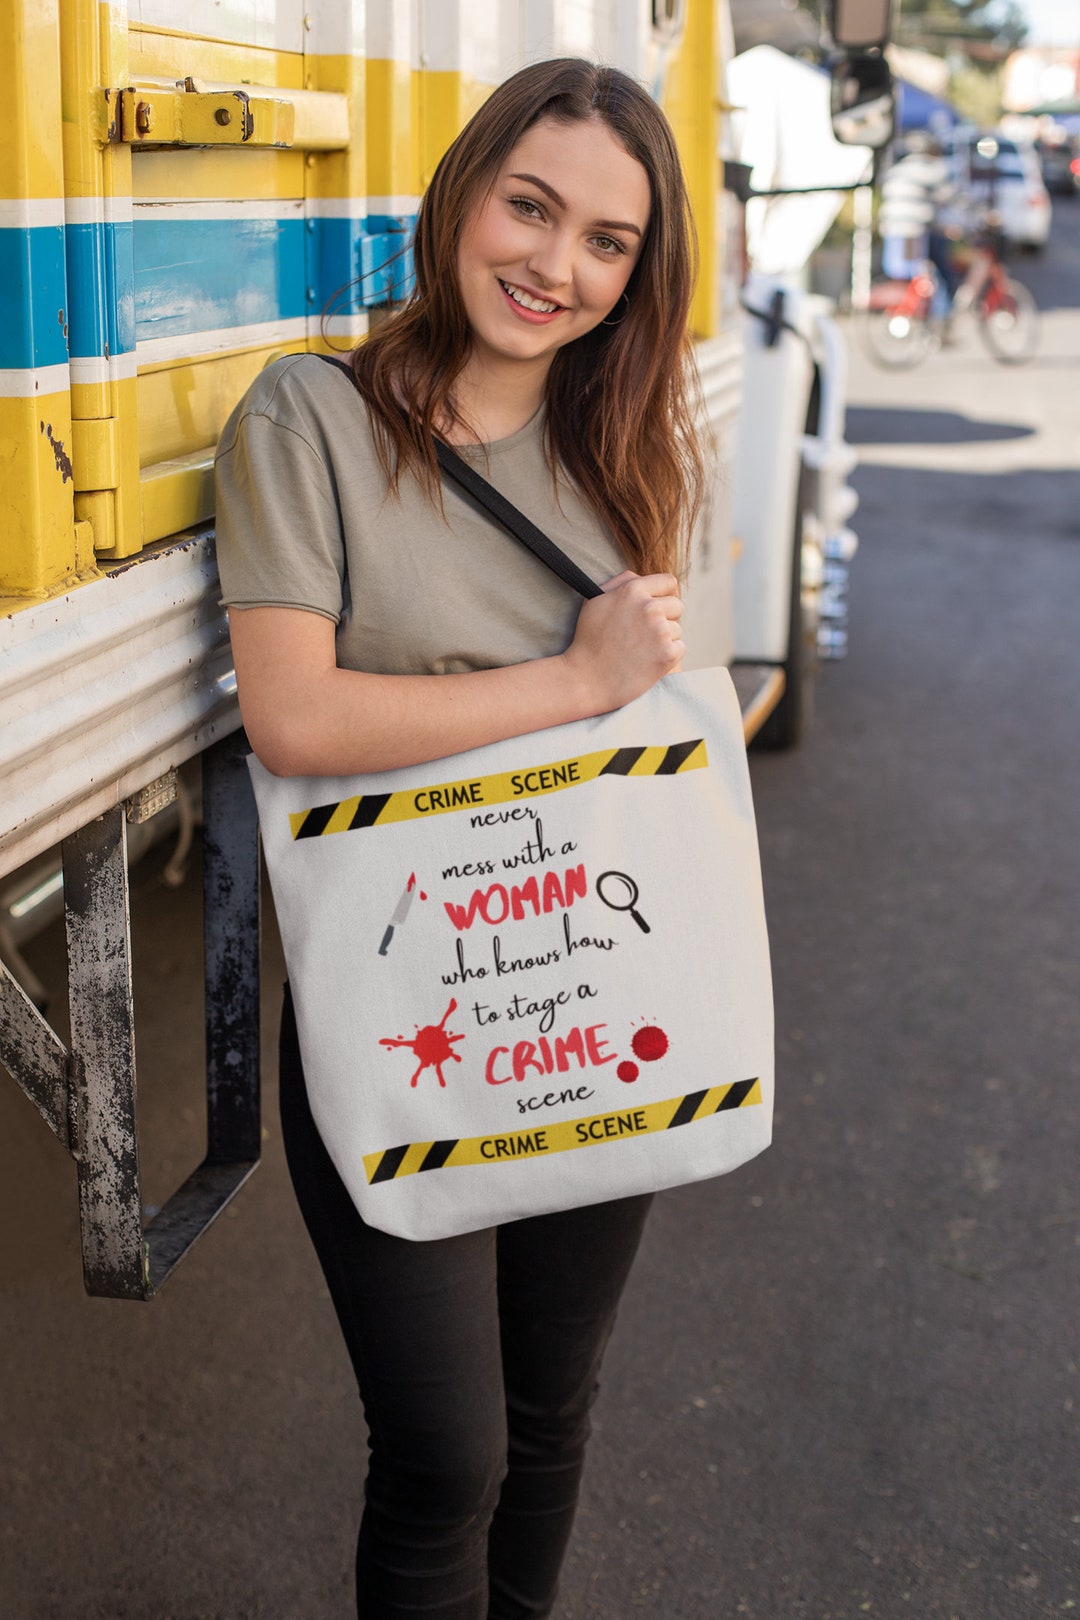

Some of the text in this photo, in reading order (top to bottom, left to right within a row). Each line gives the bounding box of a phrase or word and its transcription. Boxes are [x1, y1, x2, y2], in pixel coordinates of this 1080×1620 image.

[414, 761, 581, 813] CRIME SCENE
[470, 807, 538, 829] never
[441, 818, 578, 880] mess with a
[443, 863, 588, 931] WOMAN
[441, 912, 620, 985] who knows how
[471, 983, 598, 1034] to stage a
[485, 1023, 618, 1086] CRIME
[516, 1085, 596, 1114] scene
[479, 1111, 648, 1159] CRIME SCENE
